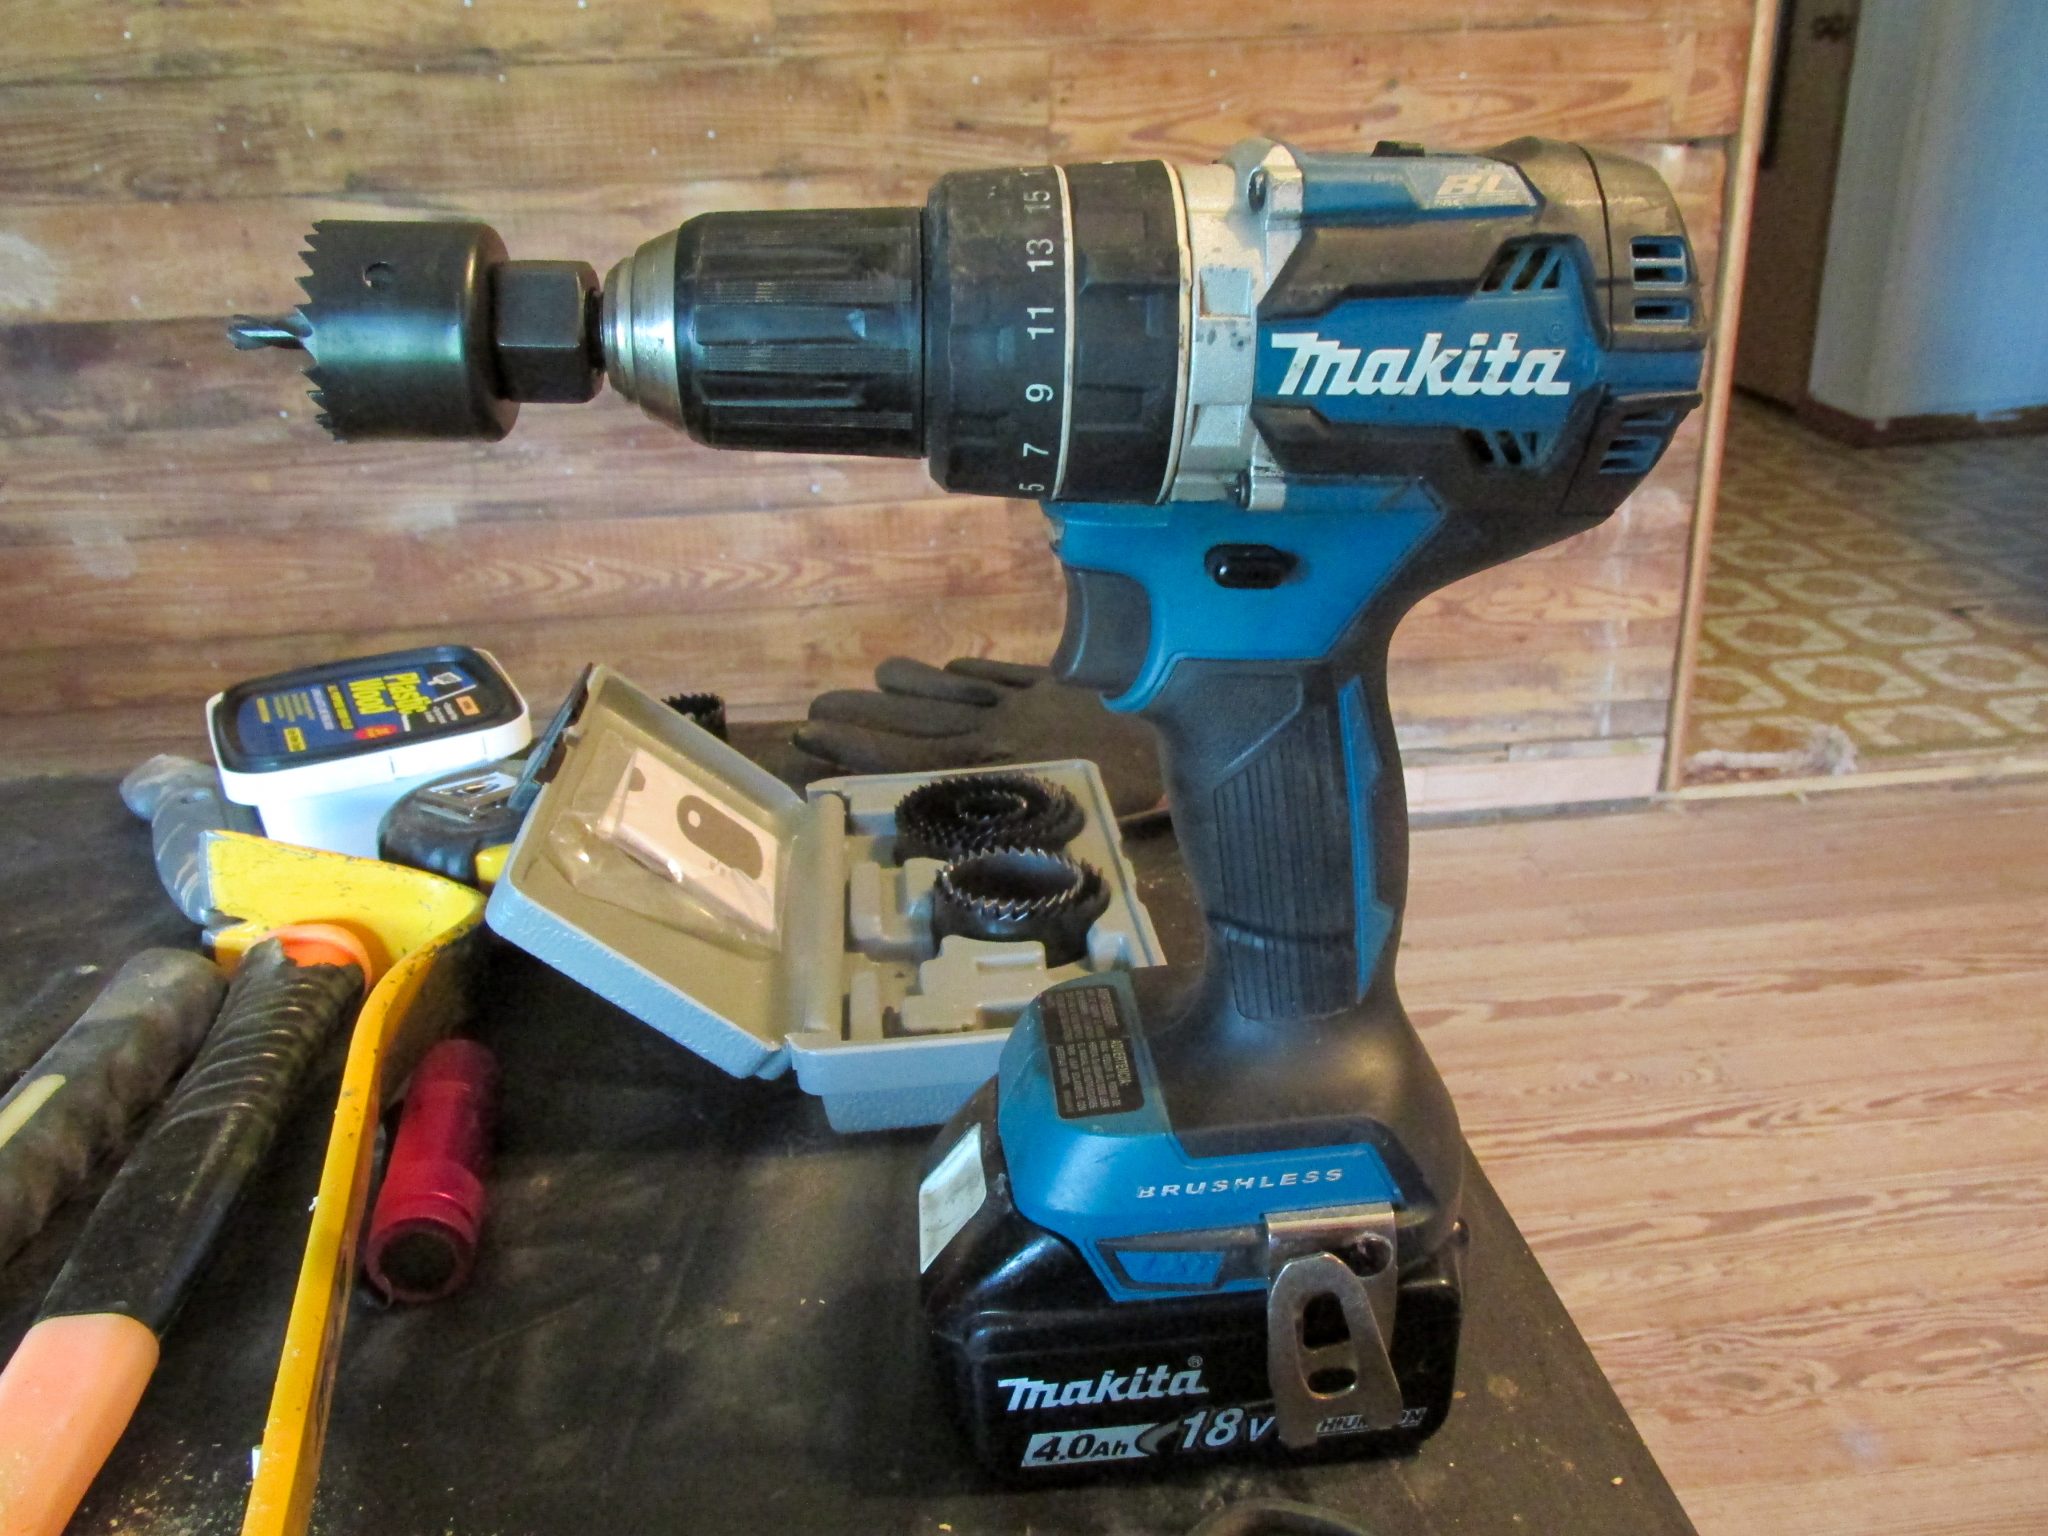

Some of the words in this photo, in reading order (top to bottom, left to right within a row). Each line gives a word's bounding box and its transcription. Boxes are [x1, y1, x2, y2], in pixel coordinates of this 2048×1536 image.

[1437, 174, 1517, 195] BL
[1023, 191, 1051, 214] 15
[1026, 238, 1054, 272] 13
[1026, 307, 1054, 340] 11
[1271, 333, 1570, 395] Makita
[1025, 384, 1054, 402] 9
[1022, 442, 1049, 457] 7
[1018, 482, 1045, 493] 5
[1136, 1168, 1343, 1199] BRUSHLESS
[1031, 1433, 1129, 1462] 4.0Ah
